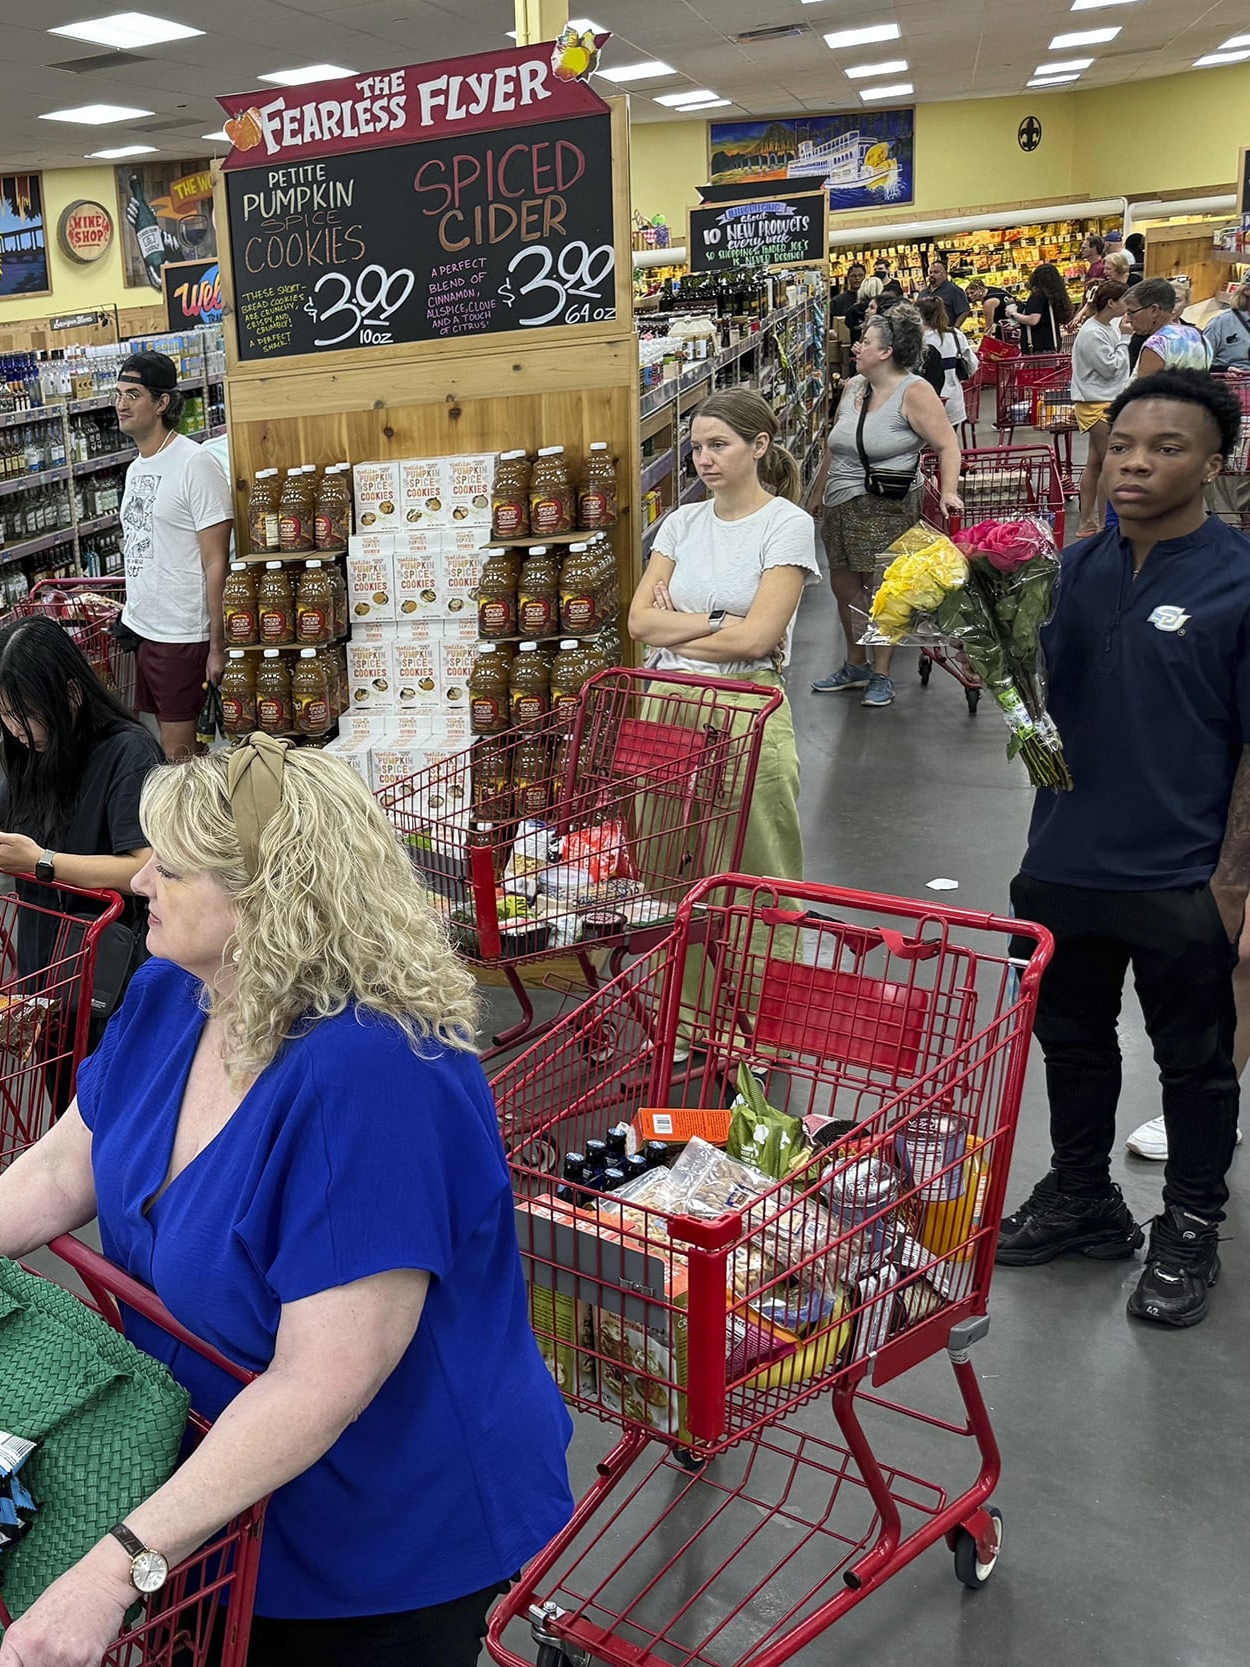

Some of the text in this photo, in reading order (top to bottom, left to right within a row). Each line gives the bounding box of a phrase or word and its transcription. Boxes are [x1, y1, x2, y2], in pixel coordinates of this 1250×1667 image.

[356, 69, 405, 98] THE
[257, 60, 552, 155] FEARLESS FLYER
[268, 164, 326, 188] PETITE
[414, 139, 586, 216] SPICED
[173, 179, 197, 200] THE
[243, 179, 354, 221] PUMPKIN
[73, 215, 103, 229] WINE
[260, 210, 342, 234] SPICE
[740, 212, 768, 223] about
[438, 195, 568, 252] CIDER
[703, 215, 810, 245] 10 NEW PRODUCTS
[74, 229, 104, 244] SHOP
[727, 232, 792, 252] every week
[245, 224, 366, 273] COOKIES
[705, 251, 715, 261] SO
[718, 248, 754, 260] SHOPPING
[761, 243, 787, 254] TRADER
[745, 254, 771, 265] NEVER
[431, 258, 487, 279] A PERFECT
[429, 271, 487, 294] BLEND OF
[242, 288, 274, 302] THESE
[241, 293, 305, 315] BREAD COOKIES
[244, 313, 260, 323] ARE
[432, 317, 451, 329] AND
[461, 311, 492, 323] TOUCH
[439, 327, 451, 336] OF
[258, 332, 292, 346] PERFECT
[406, 469, 440, 478] PUMPKIN
[452, 466, 488, 475] PUMPKIN
[359, 473, 393, 481] PUMPKIN
[456, 475, 482, 485] SPICE
[363, 481, 387, 491] SPICE
[409, 478, 435, 488] SPICE
[406, 488, 441, 498] COOKIES
[453, 484, 488, 494] COOKIES
[360, 491, 394, 501] COOKIES
[353, 564, 386, 573] PUMPKIN
[400, 561, 434, 570] PUMPKIN
[448, 559, 482, 568] PUMPKIN
[356, 573, 381, 581] SPICE
[404, 570, 429, 579] SPICE
[451, 568, 477, 577] SPICE
[354, 582, 388, 591] COOKIES
[401, 579, 435, 589] COOKIES
[448, 577, 479, 587] COOKIE
[353, 651, 386, 660] PUMPKIN
[398, 650, 433, 659] PUMPKIN
[446, 649, 480, 658] PUMPKIN
[356, 660, 381, 668] SPICE
[402, 659, 428, 667] SPICE
[450, 658, 474, 667] SPICE
[354, 669, 387, 678] COOKIES
[399, 668, 434, 677] COOKIES
[378, 756, 413, 765] PUMPKIN
[382, 764, 408, 774] SPICE
